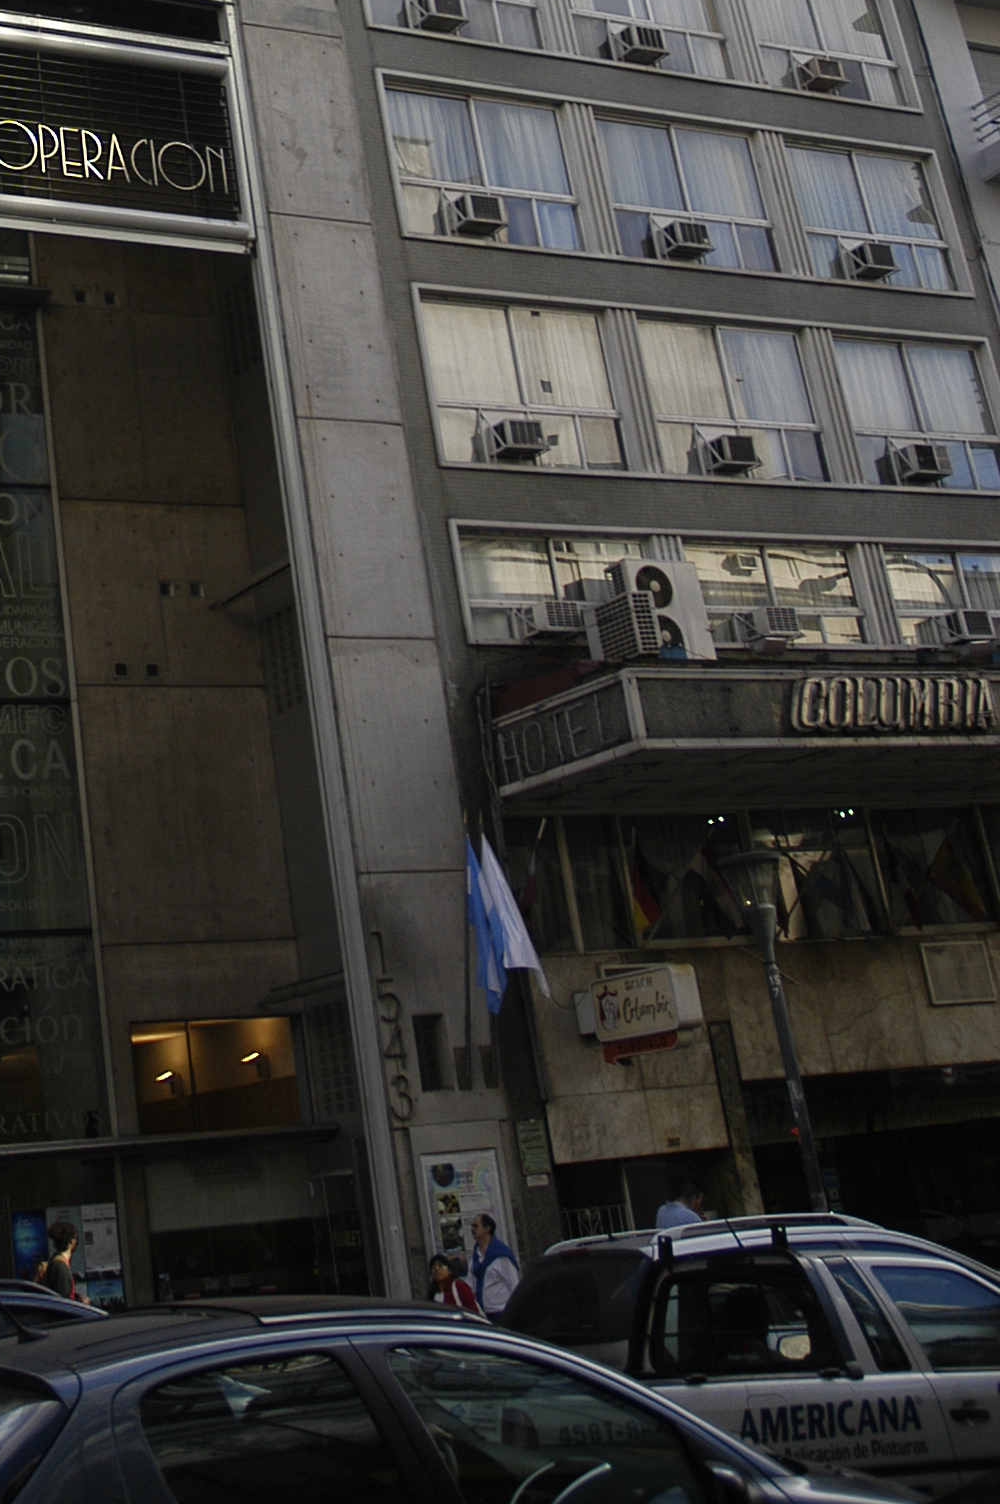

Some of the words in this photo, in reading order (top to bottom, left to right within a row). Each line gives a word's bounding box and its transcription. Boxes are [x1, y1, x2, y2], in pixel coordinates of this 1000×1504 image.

[797, 676, 997, 733] COLUMBIA
[497, 694, 620, 786] HOTEL
[739, 1394, 923, 1446] AMERICANA
[853, 1444, 869, 1460] de
[870, 1438, 929, 1458] Pinturas
